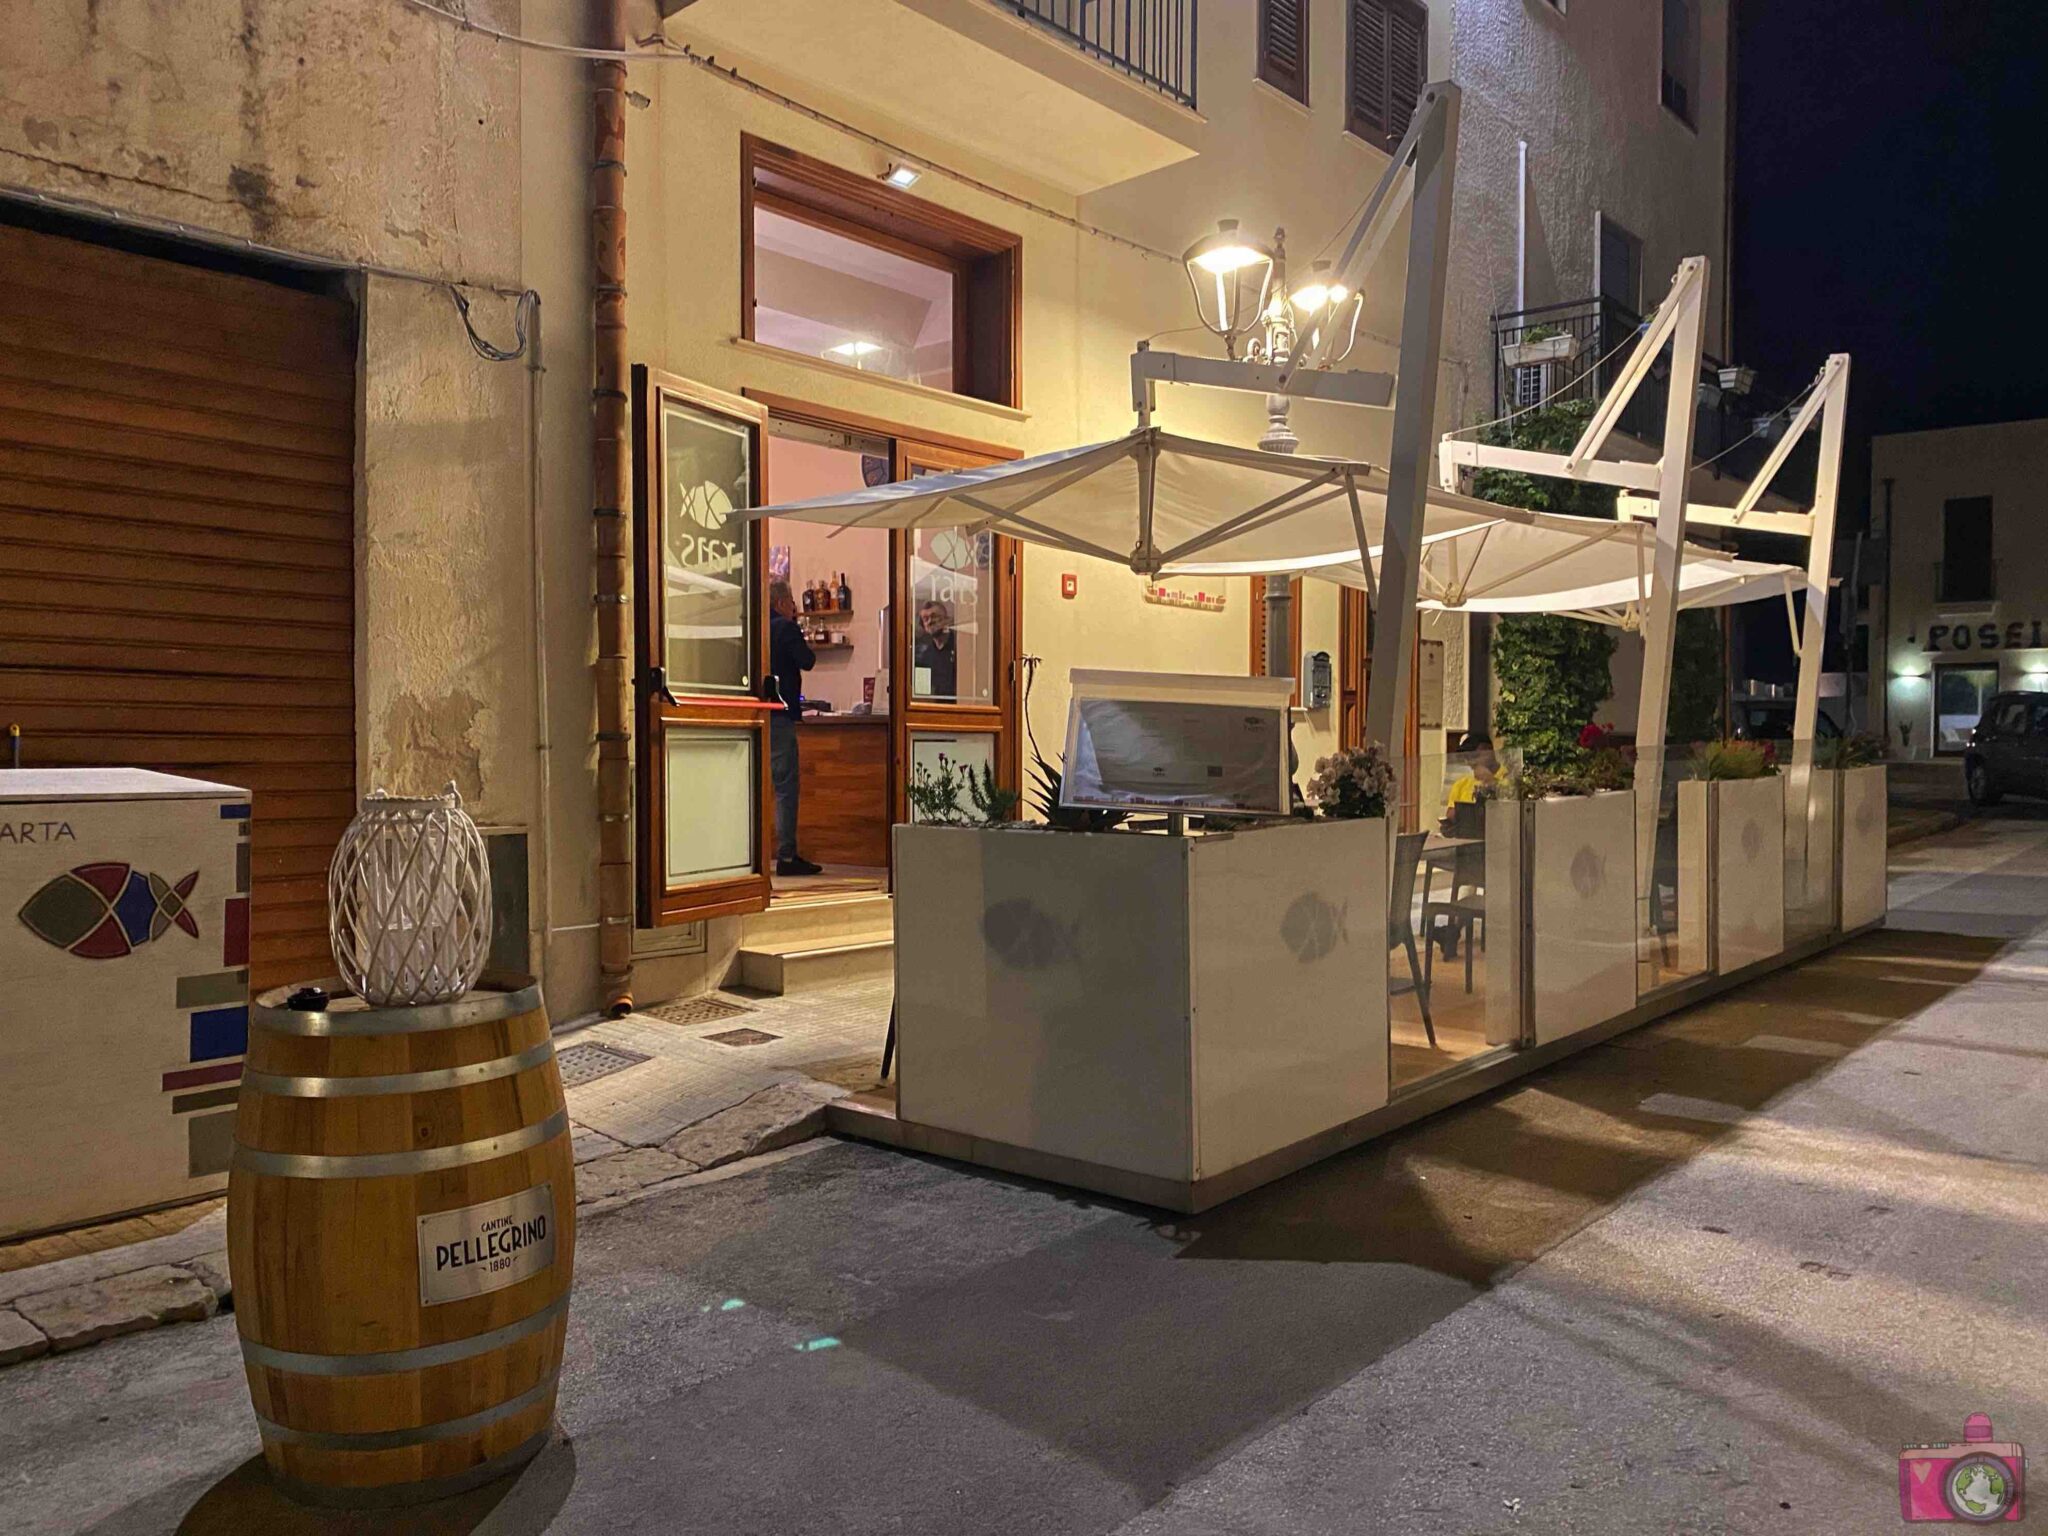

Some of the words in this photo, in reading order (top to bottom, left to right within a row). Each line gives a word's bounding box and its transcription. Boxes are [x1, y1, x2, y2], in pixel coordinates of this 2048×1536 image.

[1923, 620, 2042, 652] POSEI
[481, 1214, 513, 1232] CANTINE
[436, 1215, 546, 1271] PELLEGRINO
